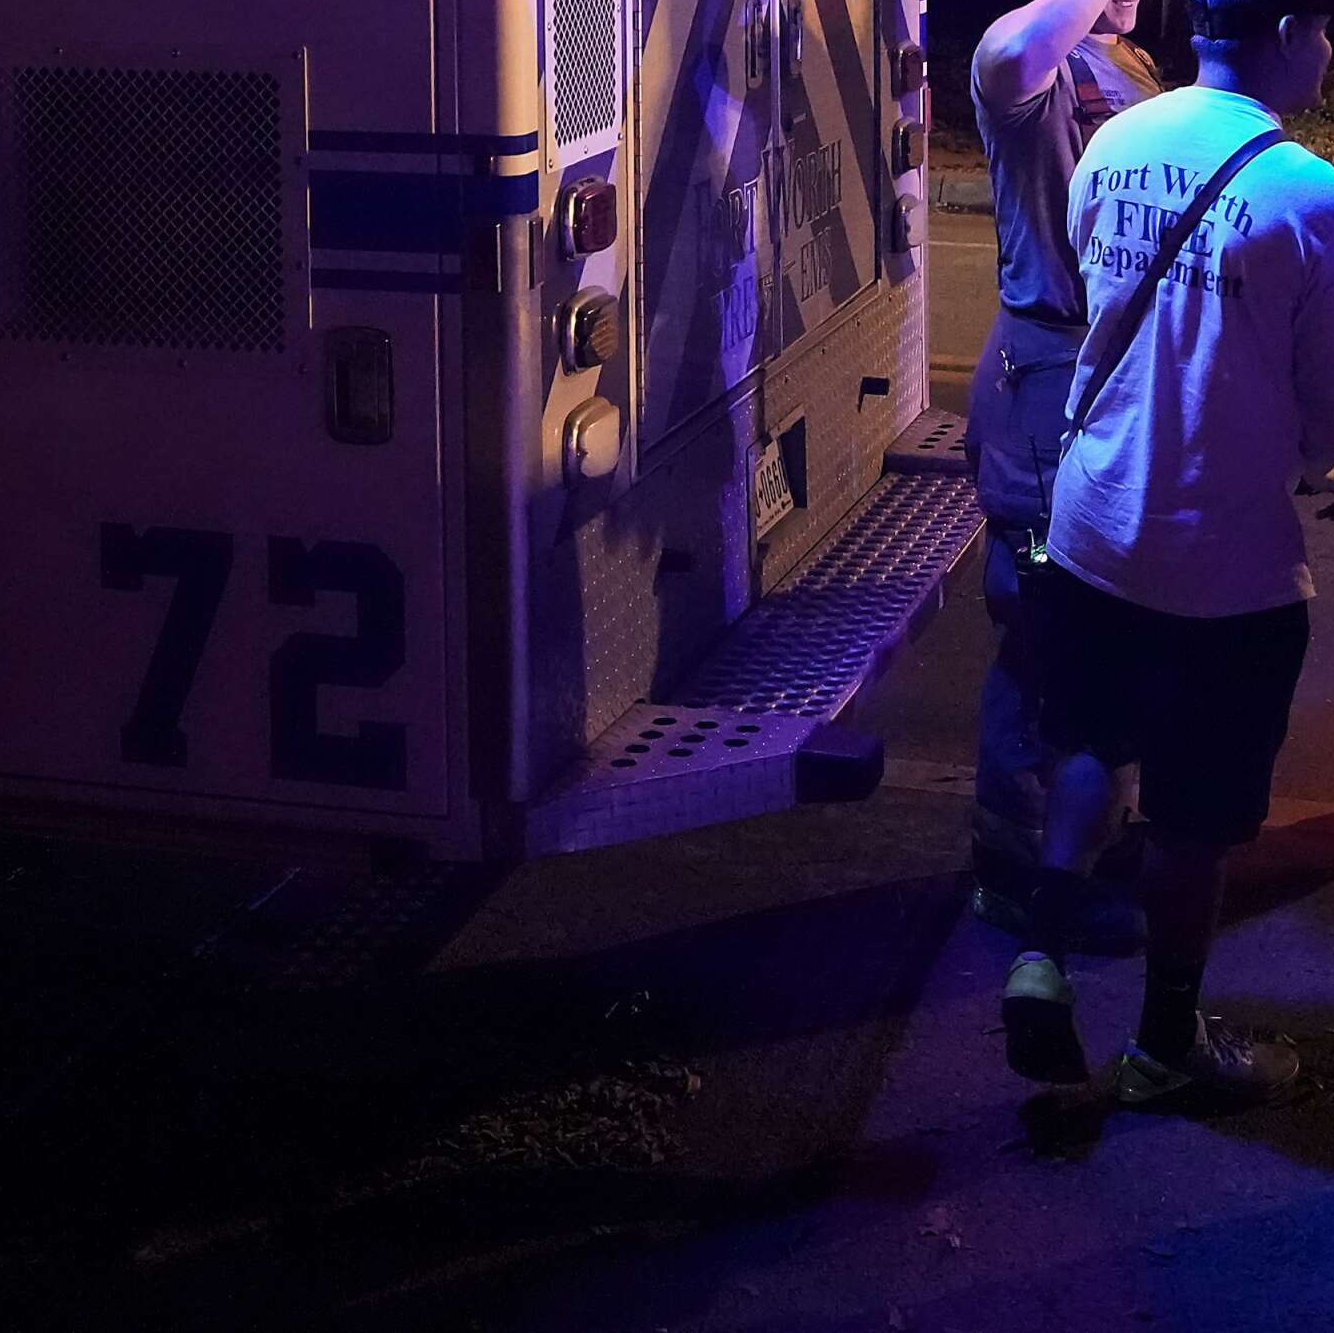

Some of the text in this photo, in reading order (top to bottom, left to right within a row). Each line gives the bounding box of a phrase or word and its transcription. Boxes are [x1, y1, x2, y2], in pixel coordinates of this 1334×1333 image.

[762, 138, 842, 245] WORTH
[1091, 163, 1151, 200] Fort
[1089, 236, 1243, 299] Depament
[100, 522, 406, 790] 72
